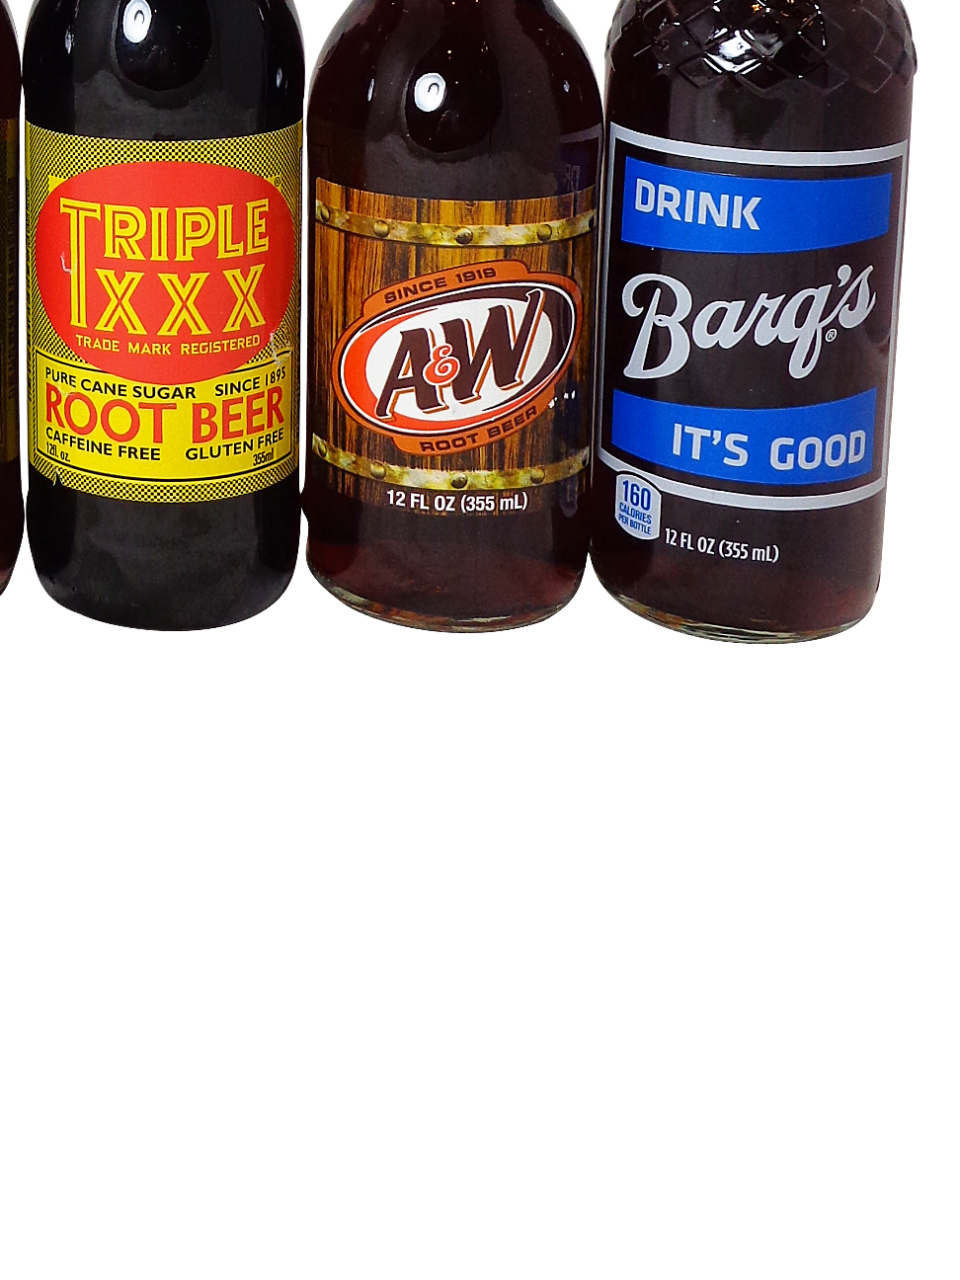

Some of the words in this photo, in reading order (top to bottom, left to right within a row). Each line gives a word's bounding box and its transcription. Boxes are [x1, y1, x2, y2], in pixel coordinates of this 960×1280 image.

[634, 177, 762, 231] DRINK
[94, 263, 267, 336] XXX
[384, 276, 448, 303] SINCE
[455, 267, 497, 284] 1919
[621, 264, 877, 380] Barq's
[76, 334, 120, 352] TRADE
[128, 342, 172, 355] MARK
[180, 335, 260, 355] REGISTERED
[376, 288, 546, 420] A&W
[45, 366, 76, 388] PURE
[80, 376, 127, 397] CANE
[133, 385, 196, 399] SUGAR
[215, 376, 260, 397] SINCE
[264, 368, 286, 388] 1895
[46, 382, 177, 444] ROOT
[192, 385, 285, 444] BEER
[419, 433, 478, 452] ROOT
[489, 405, 538, 439] BEER
[46, 427, 113, 458] CAFFEINE
[118, 446, 161, 461] FREE
[185, 441, 254, 461] GLUTEN
[257, 427, 284, 449] FREE
[253, 449, 275, 467] 355ml
[671, 423, 749, 467] IT'S
[769, 429, 867, 472] GOOD
[386, 490, 406, 507] 12
[410, 493, 429, 509] FL
[434, 495, 456, 511] OZ
[460, 494, 496, 514] (355
[499, 491, 528, 512] mL)
[619, 502, 652, 525] CALORIES
[622, 480, 652, 511] 160
[618, 513, 629, 526] PER
[629, 517, 652, 535] BOTTLE
[665, 527, 677, 547] 12
[680, 532, 694, 550] FL
[697, 536, 715, 555] OZ
[718, 539, 748, 559] (355
[752, 544, 779, 563] mL)
